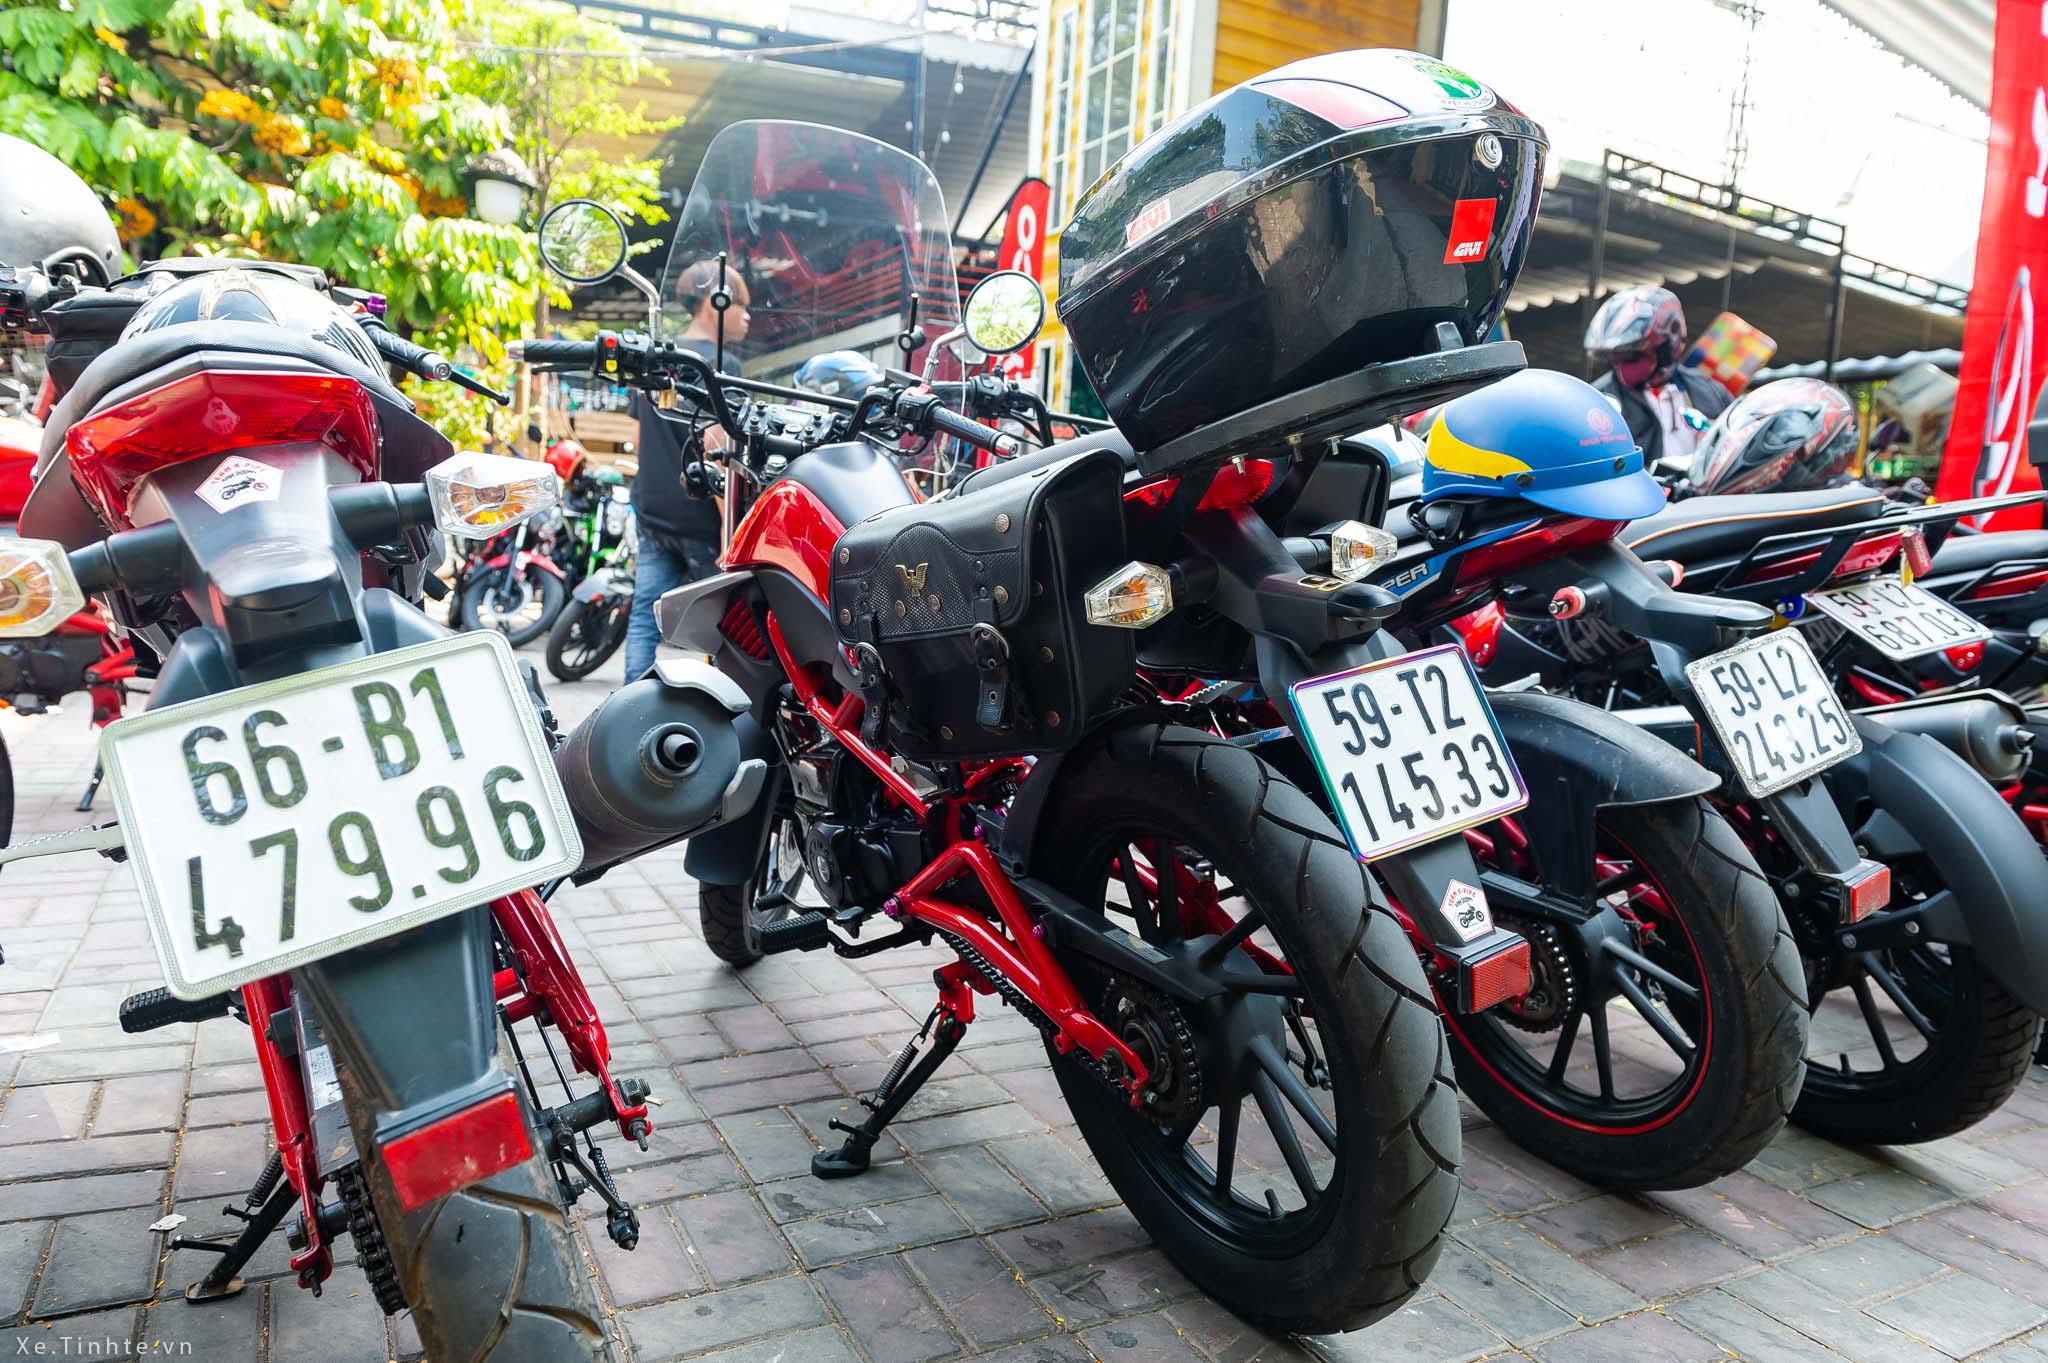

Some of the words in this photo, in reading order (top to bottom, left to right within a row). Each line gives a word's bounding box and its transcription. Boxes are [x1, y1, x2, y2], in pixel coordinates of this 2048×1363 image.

[1453, 241, 1484, 257] GIVI
[1862, 608, 1975, 650] 687.03
[1322, 664, 1466, 756] 59-T2
[1711, 645, 1808, 717] 59-L2
[182, 667, 466, 826] 66-B1
[1733, 698, 1847, 782] 243.25
[1341, 733, 1510, 842] 145.33
[188, 765, 546, 958] 479.96
